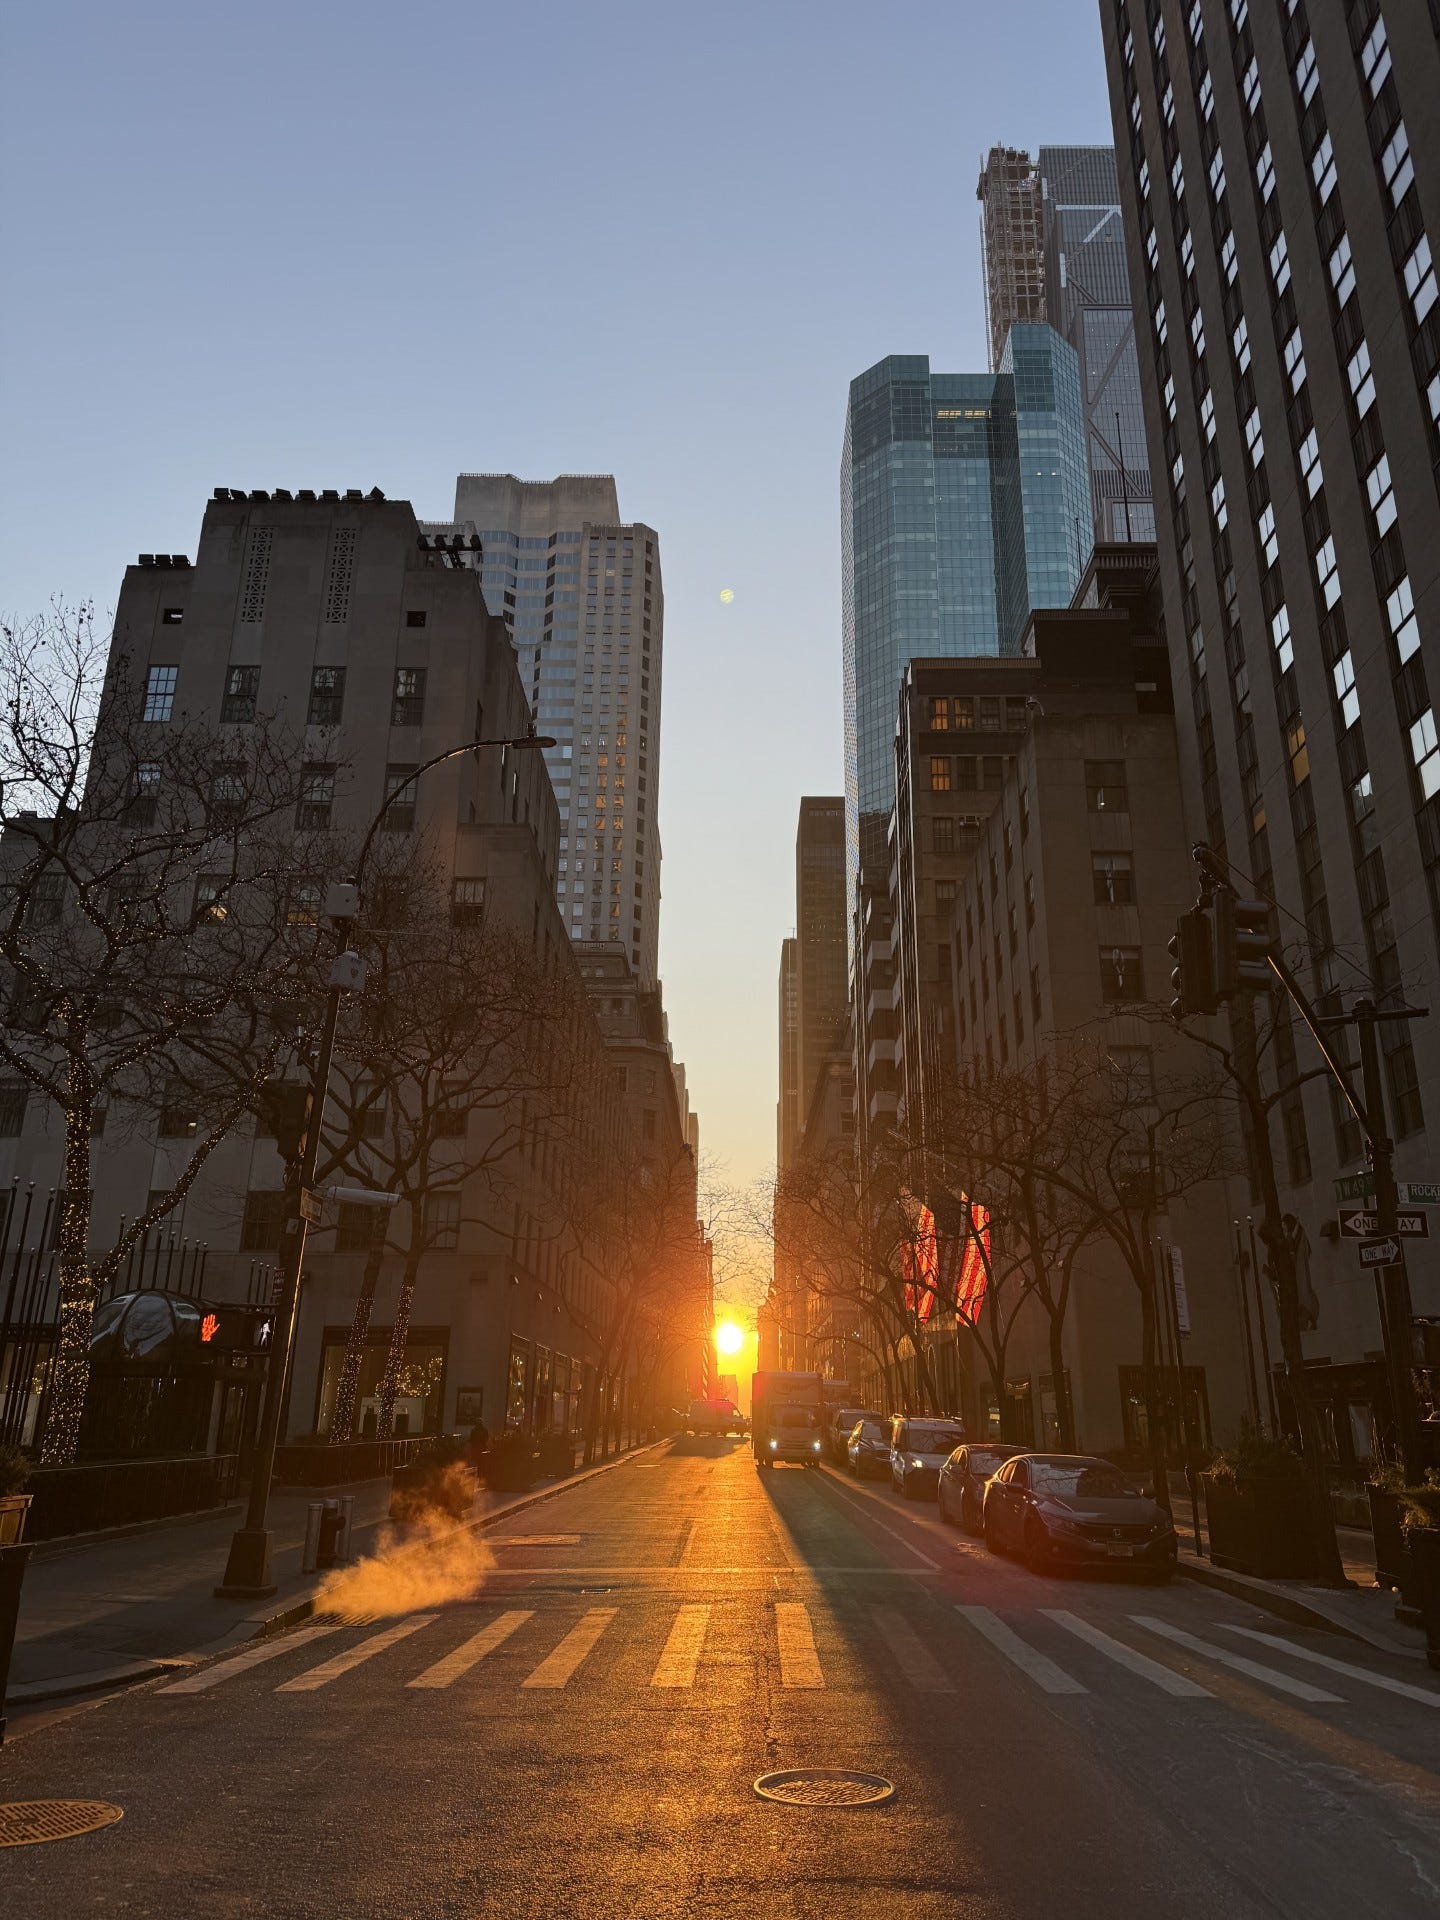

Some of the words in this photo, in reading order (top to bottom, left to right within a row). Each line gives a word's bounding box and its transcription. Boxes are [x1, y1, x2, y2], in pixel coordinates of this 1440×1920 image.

[1353, 1219, 1377, 1229] ONE
[1364, 1248, 1378, 1260] ONE
[1382, 1245, 1395, 1257] WAY
